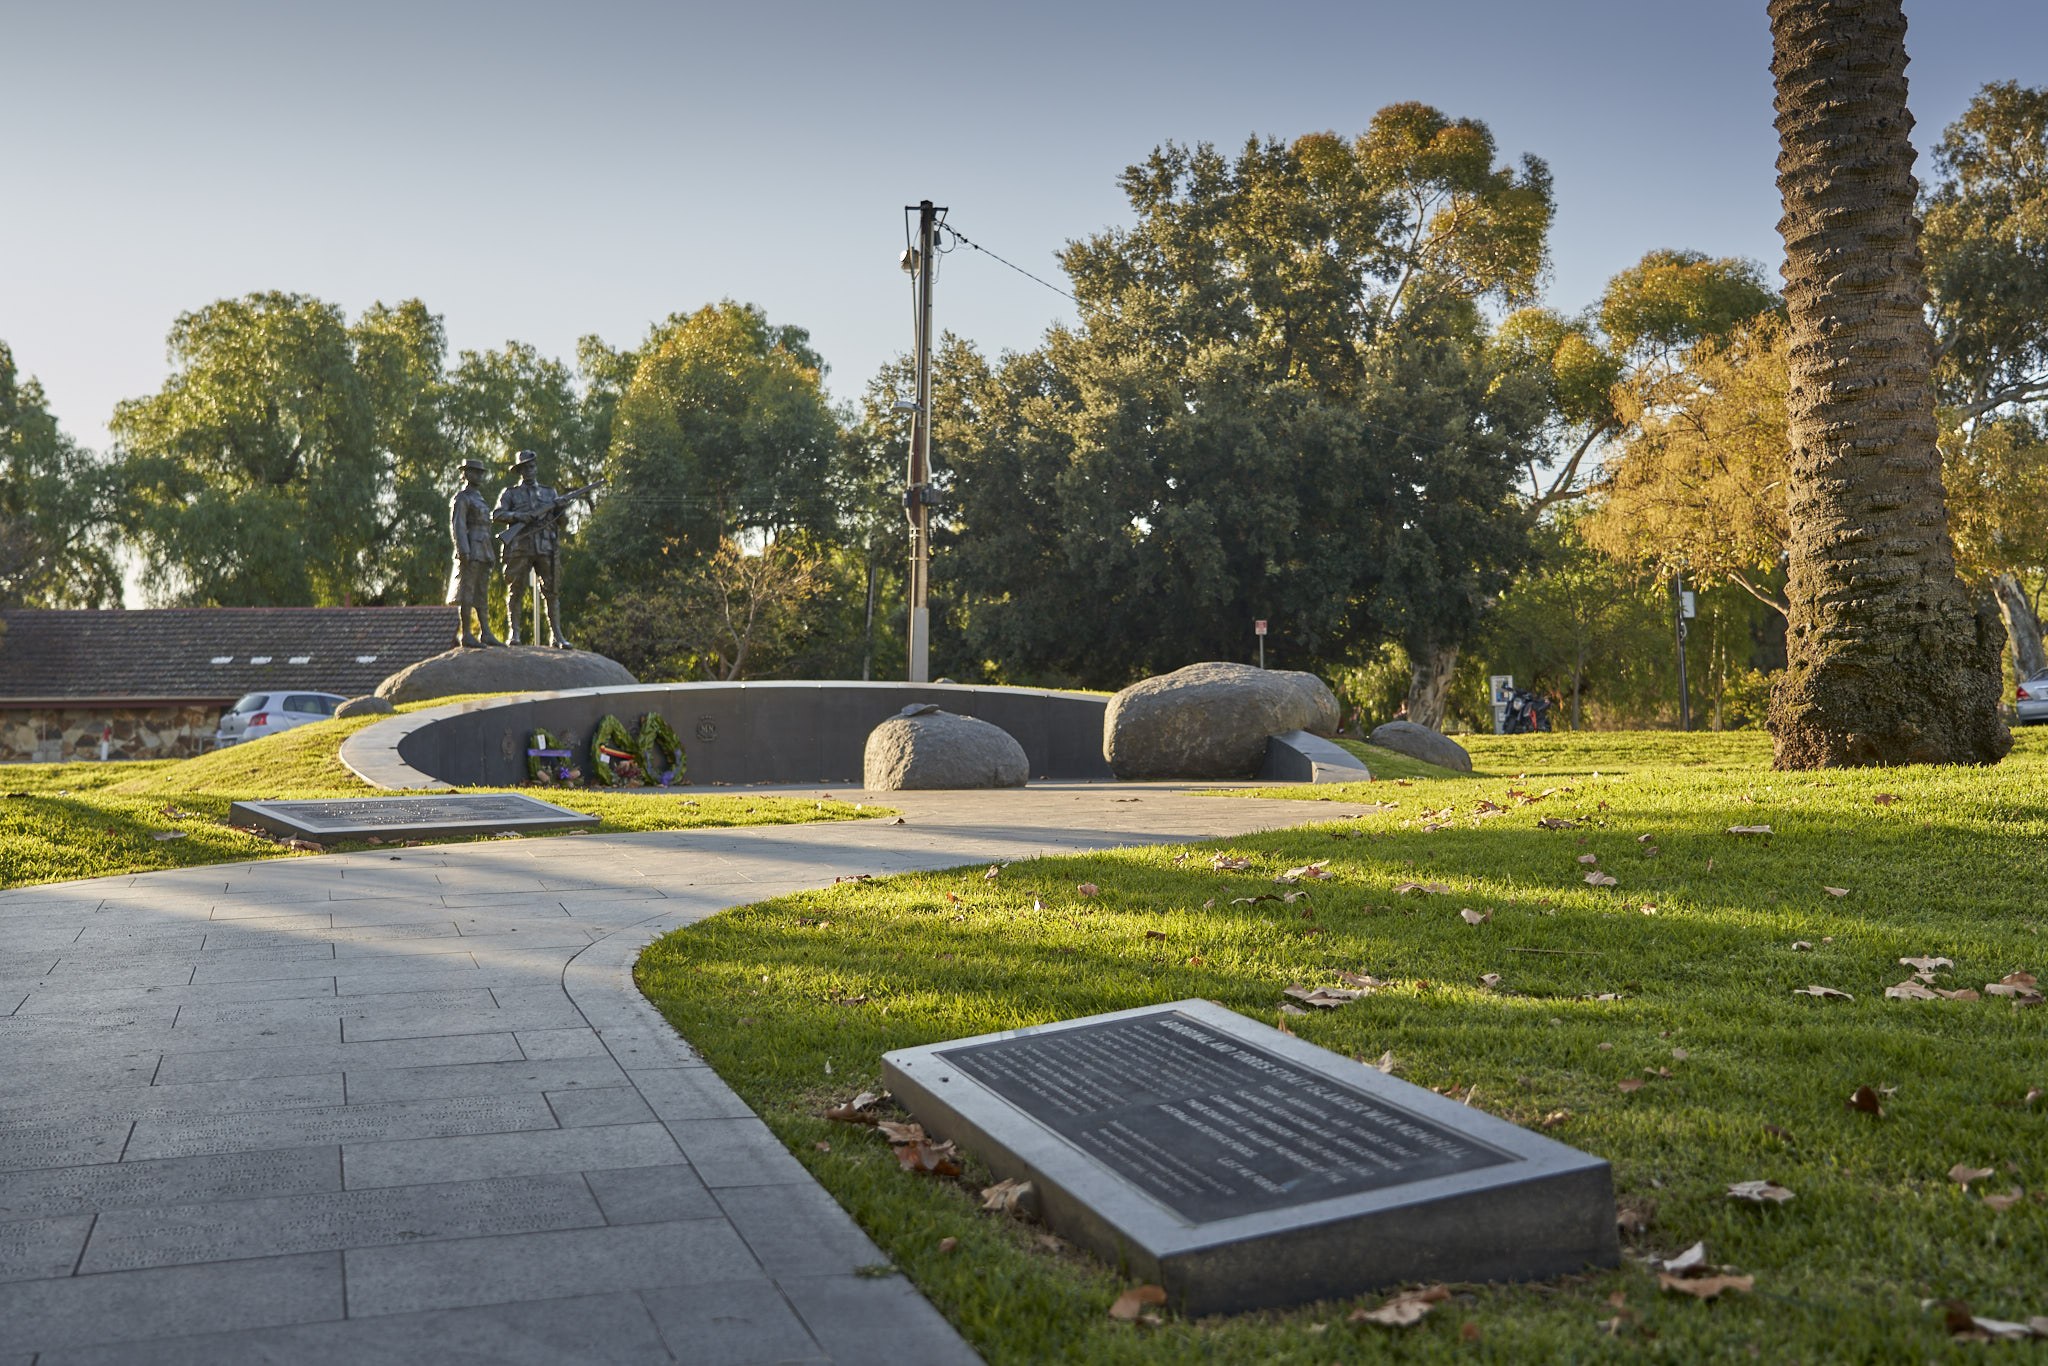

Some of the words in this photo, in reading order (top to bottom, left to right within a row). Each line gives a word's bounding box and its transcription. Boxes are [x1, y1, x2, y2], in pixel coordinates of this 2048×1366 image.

[1156, 1019, 1219, 1043] ABORIGINAL
[1206, 1041, 1239, 1052] AND
[1225, 1050, 1277, 1069] TORRES
[1263, 1067, 1315, 1086] STRAIT
[1302, 1084, 1373, 1112] ISLANDER
[1358, 1109, 1404, 1125] WAR
[1389, 1123, 1476, 1158] MEMORIAL
